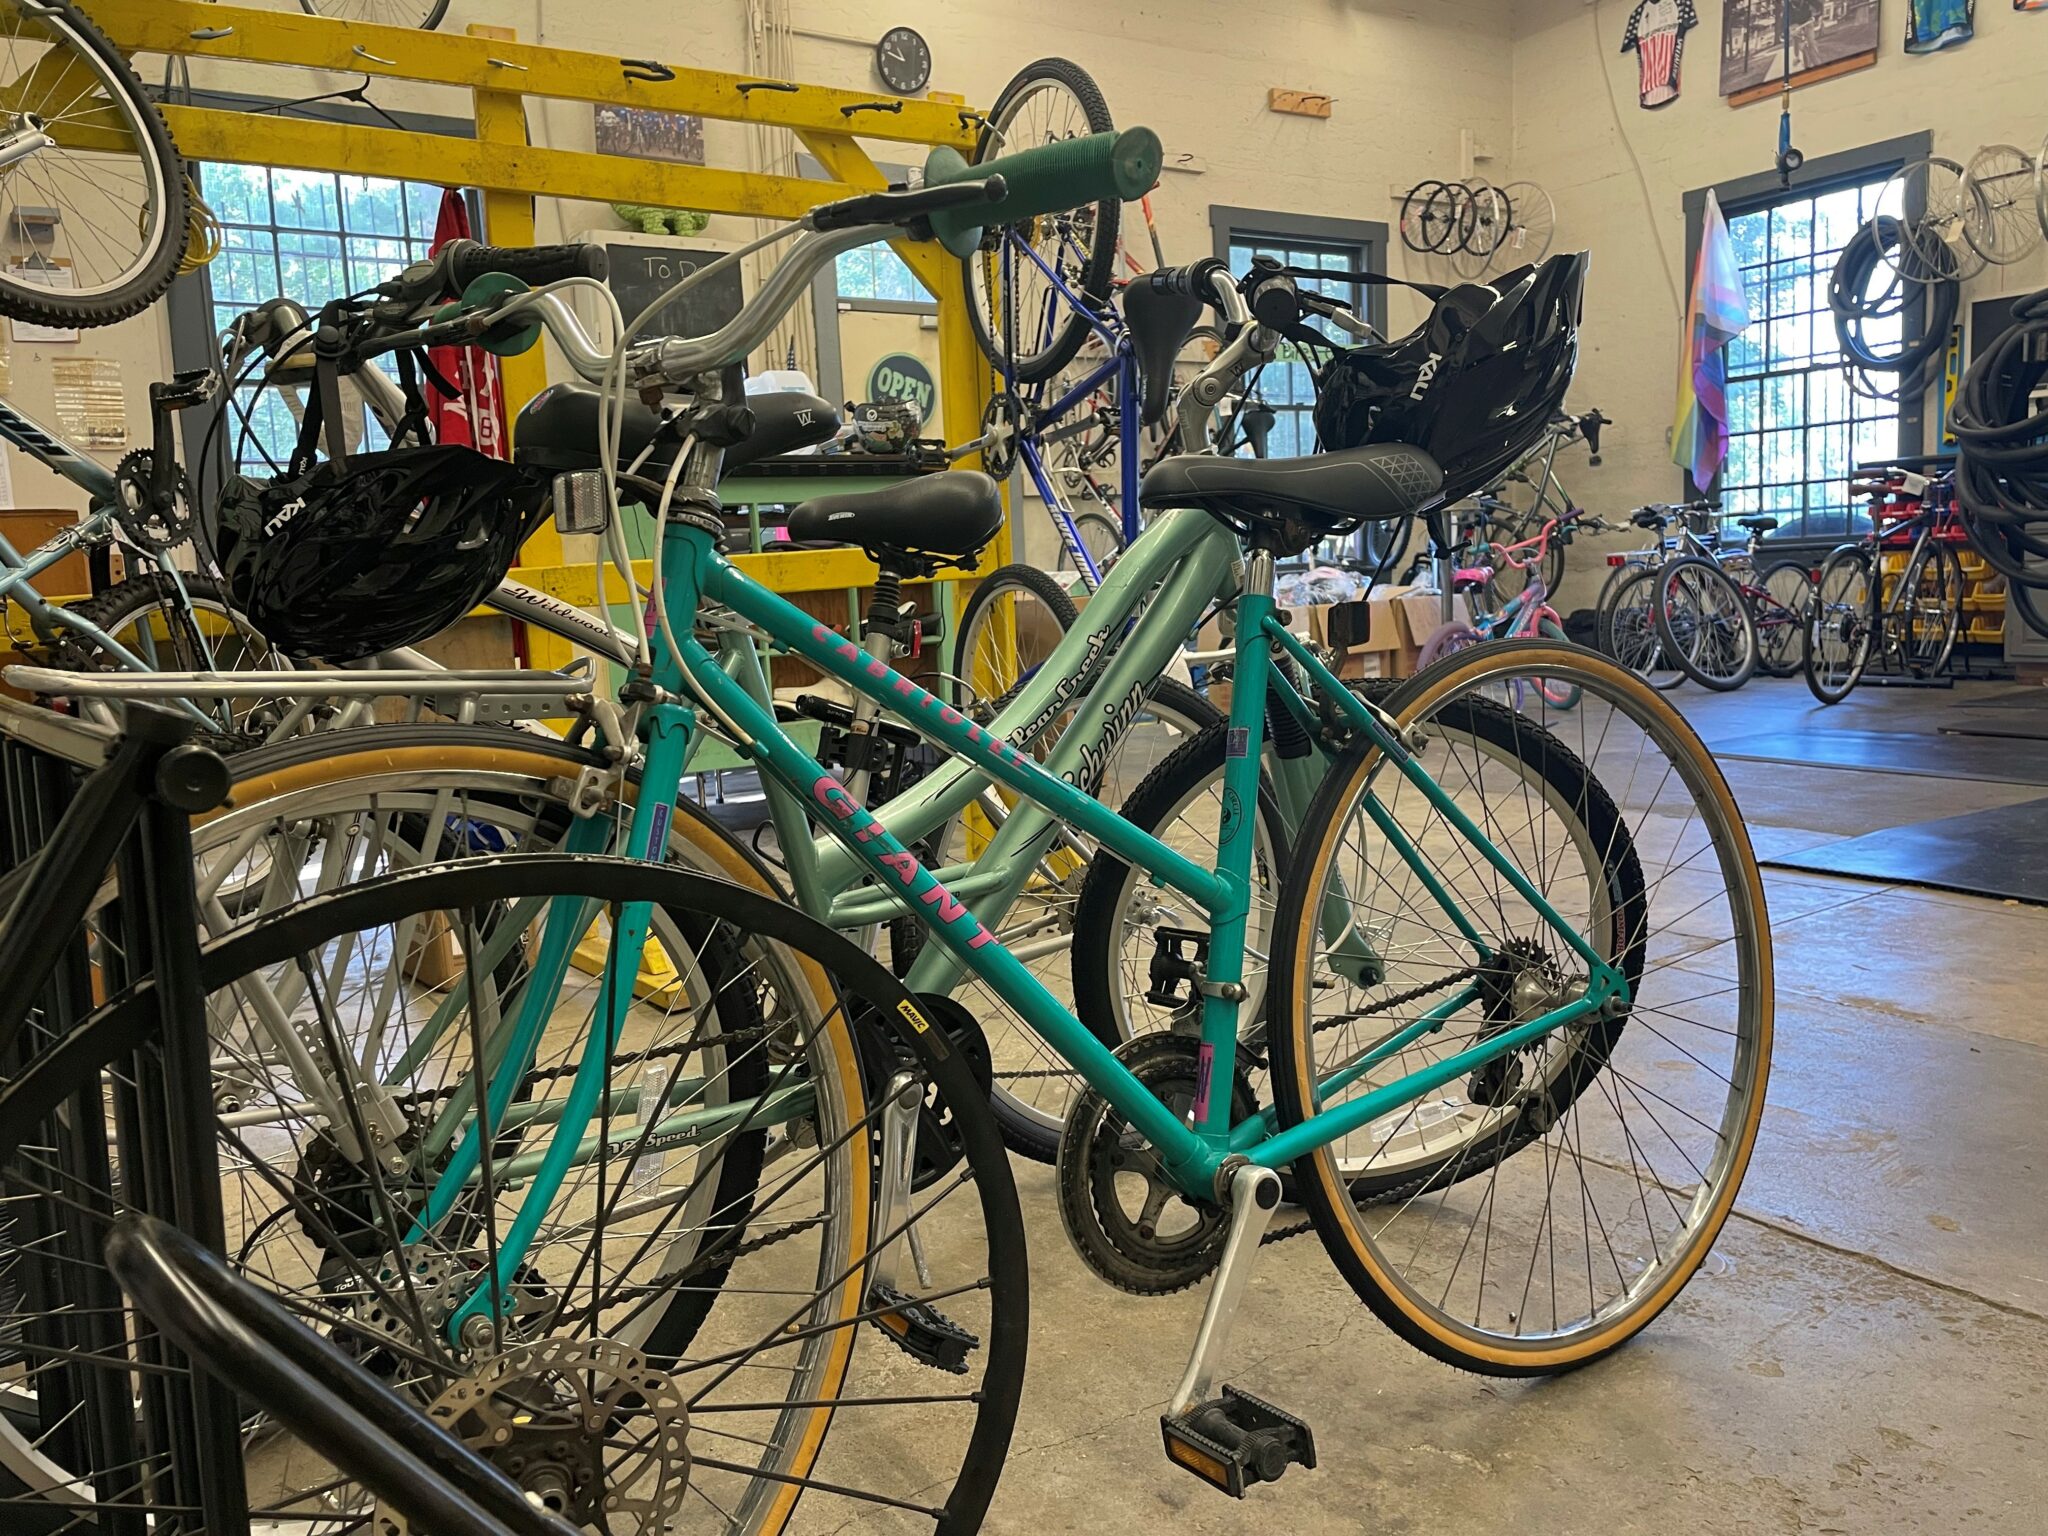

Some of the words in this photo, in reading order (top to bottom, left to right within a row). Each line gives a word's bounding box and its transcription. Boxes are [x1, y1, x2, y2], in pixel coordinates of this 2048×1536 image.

[679, 260, 706, 281] D
[877, 366, 932, 408] OPEN
[1409, 352, 1443, 401] KALI
[264, 496, 306, 537] KALI
[1071, 551, 1100, 593] UNIO
[811, 625, 1027, 767] CABRIOLET
[813, 776, 1000, 949] GIANT
[900, 1004, 926, 1029] MAVIC
[644, 1123, 702, 1148] Speed
